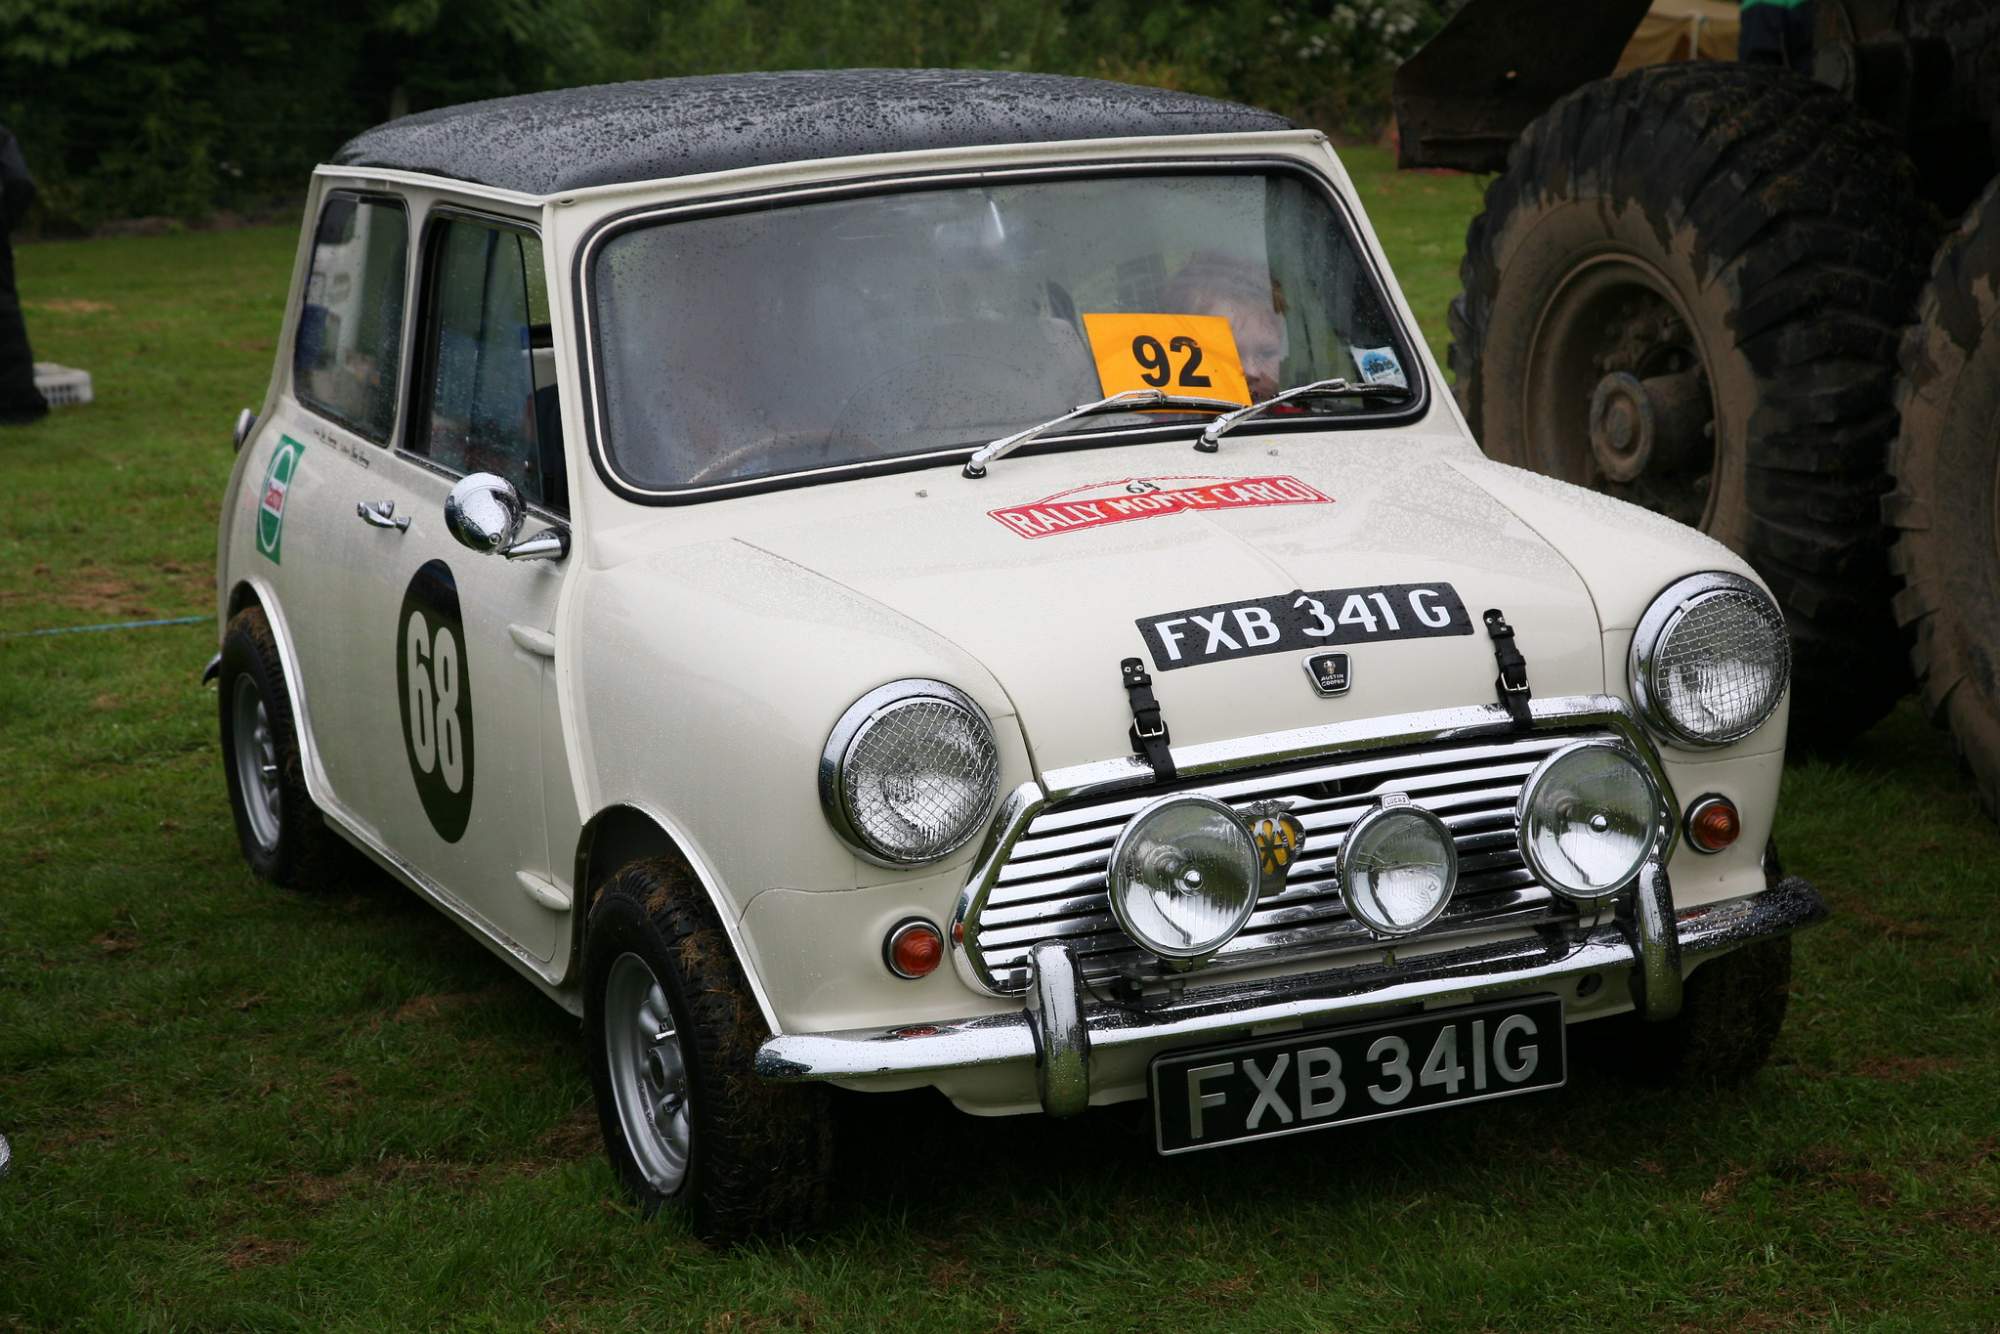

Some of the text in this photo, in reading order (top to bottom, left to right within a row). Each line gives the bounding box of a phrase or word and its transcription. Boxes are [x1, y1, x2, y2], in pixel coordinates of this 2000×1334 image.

[1132, 335, 1212, 388] 92
[1000, 480, 1318, 534] RALLY MONTE CARLO
[1154, 607, 1281, 661] FXB
[406, 610, 464, 794] 68
[1321, 673, 1344, 681] AUSTIN
[1321, 679, 1345, 687] COOPER
[1385, 797, 1406, 805] LUCAS
[1187, 1014, 1539, 1139] FXB 341G
